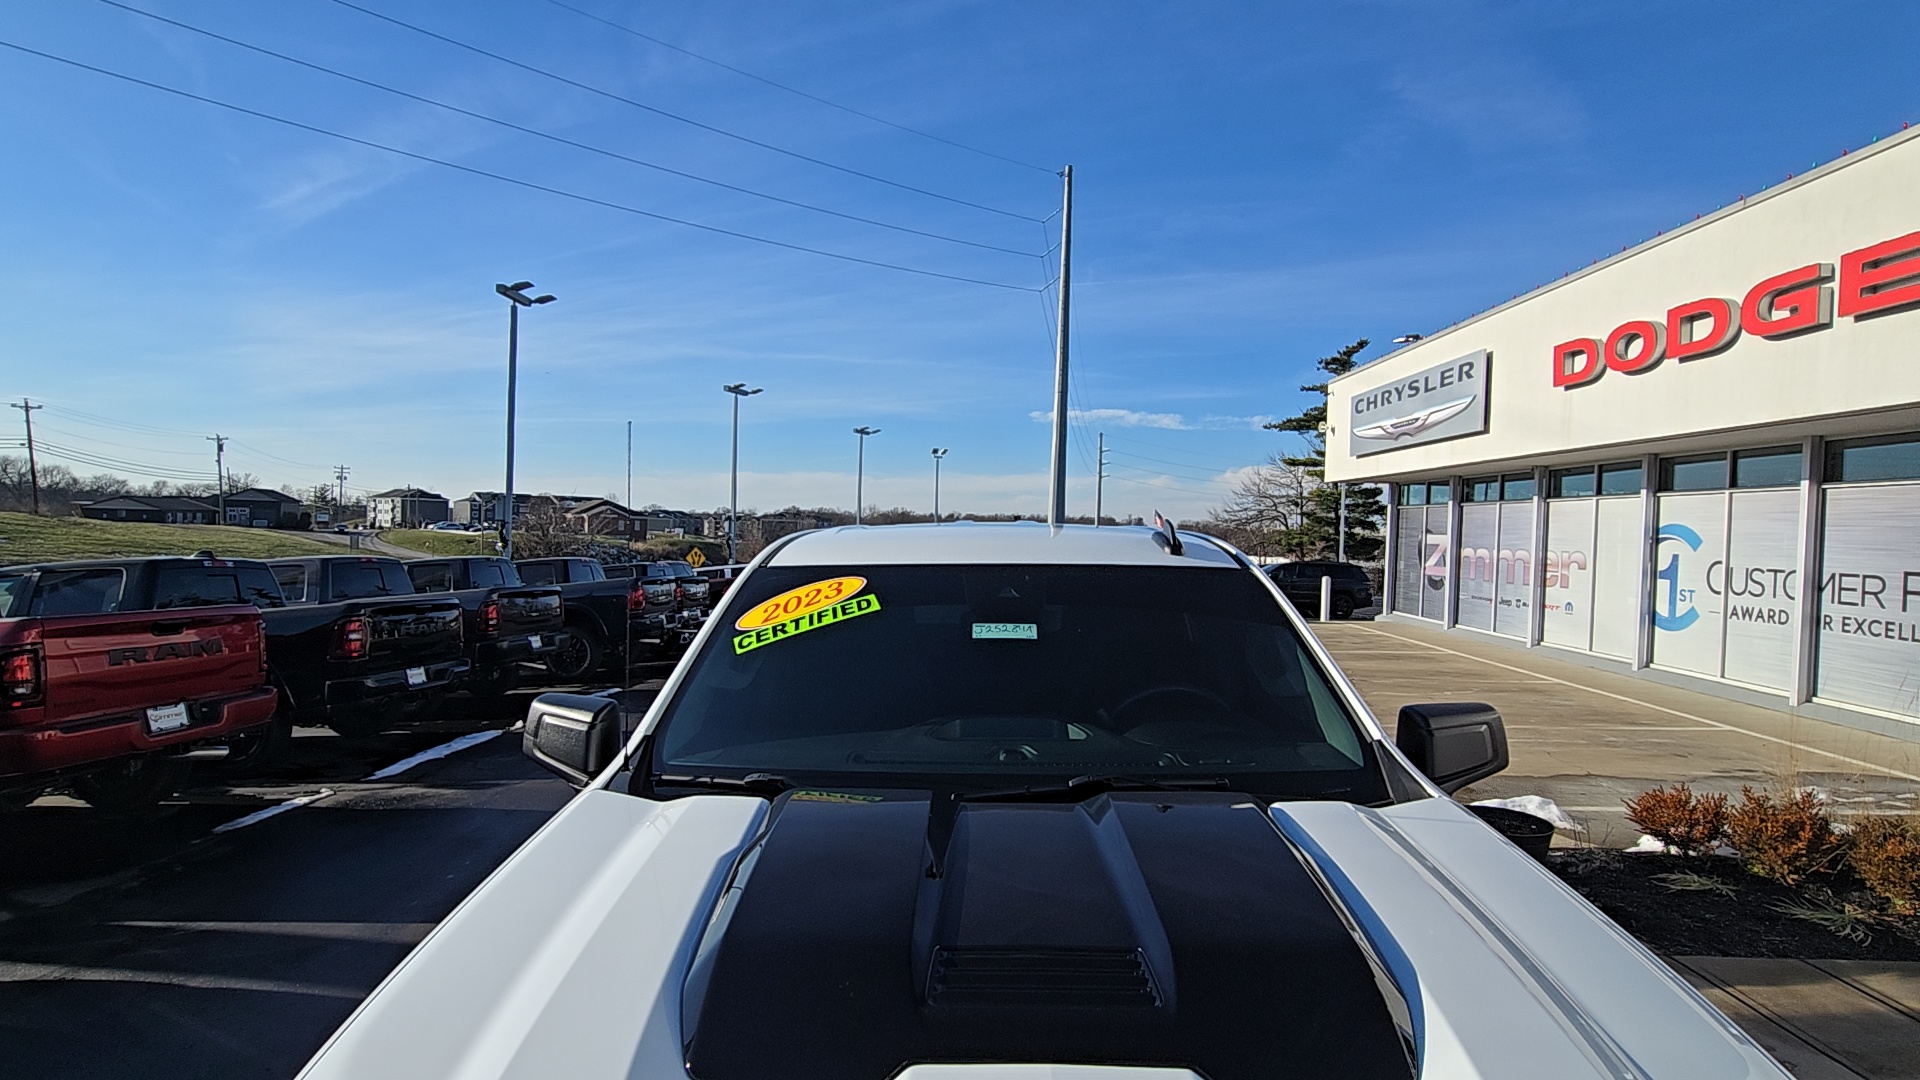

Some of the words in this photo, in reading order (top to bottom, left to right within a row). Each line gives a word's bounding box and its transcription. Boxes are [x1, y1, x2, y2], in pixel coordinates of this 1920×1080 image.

[1553, 231, 1920, 388] DODGE
[1355, 361, 1475, 415] CHRYSLER
[737, 598, 872, 650] CERTIFIED
[761, 581, 844, 624] 2023
[1729, 605, 1790, 626] AWARD
[109, 637, 224, 666] RAM
